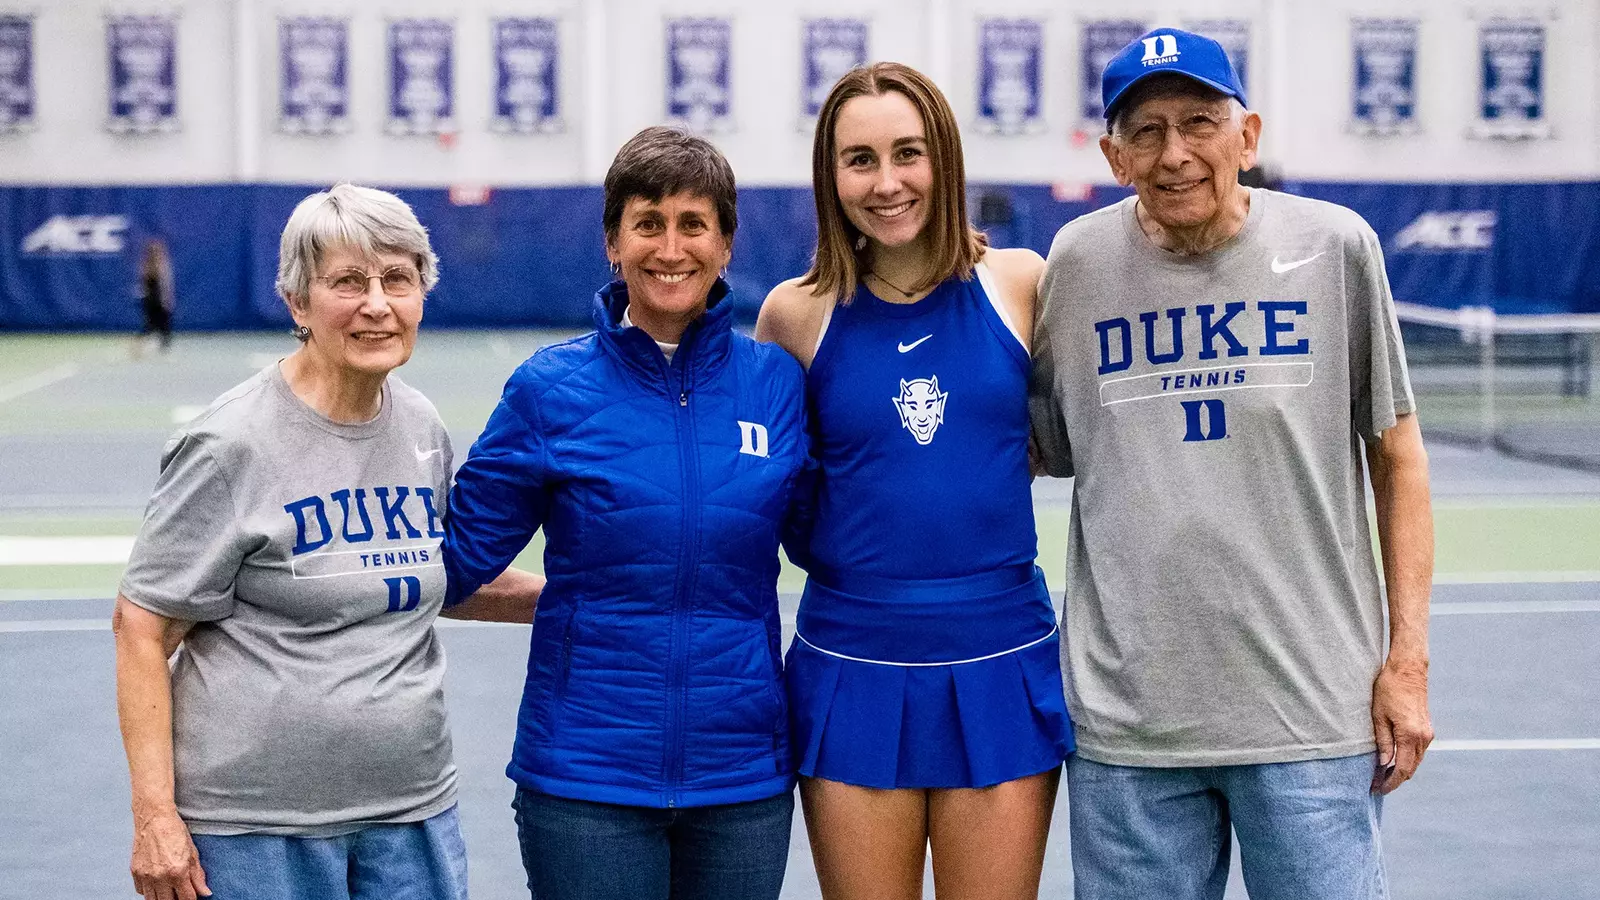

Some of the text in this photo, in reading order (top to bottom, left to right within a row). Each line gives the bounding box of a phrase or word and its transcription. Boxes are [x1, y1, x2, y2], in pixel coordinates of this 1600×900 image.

[1141, 55, 1179, 68] TENNIS
[22, 214, 128, 253] ACC
[1394, 210, 1498, 250] ACC
[1094, 301, 1310, 376] DUKE
[1160, 369, 1247, 391] TENNIS
[737, 420, 769, 458] D
[1180, 399, 1228, 442] D
[360, 549, 430, 568] TENNIS
